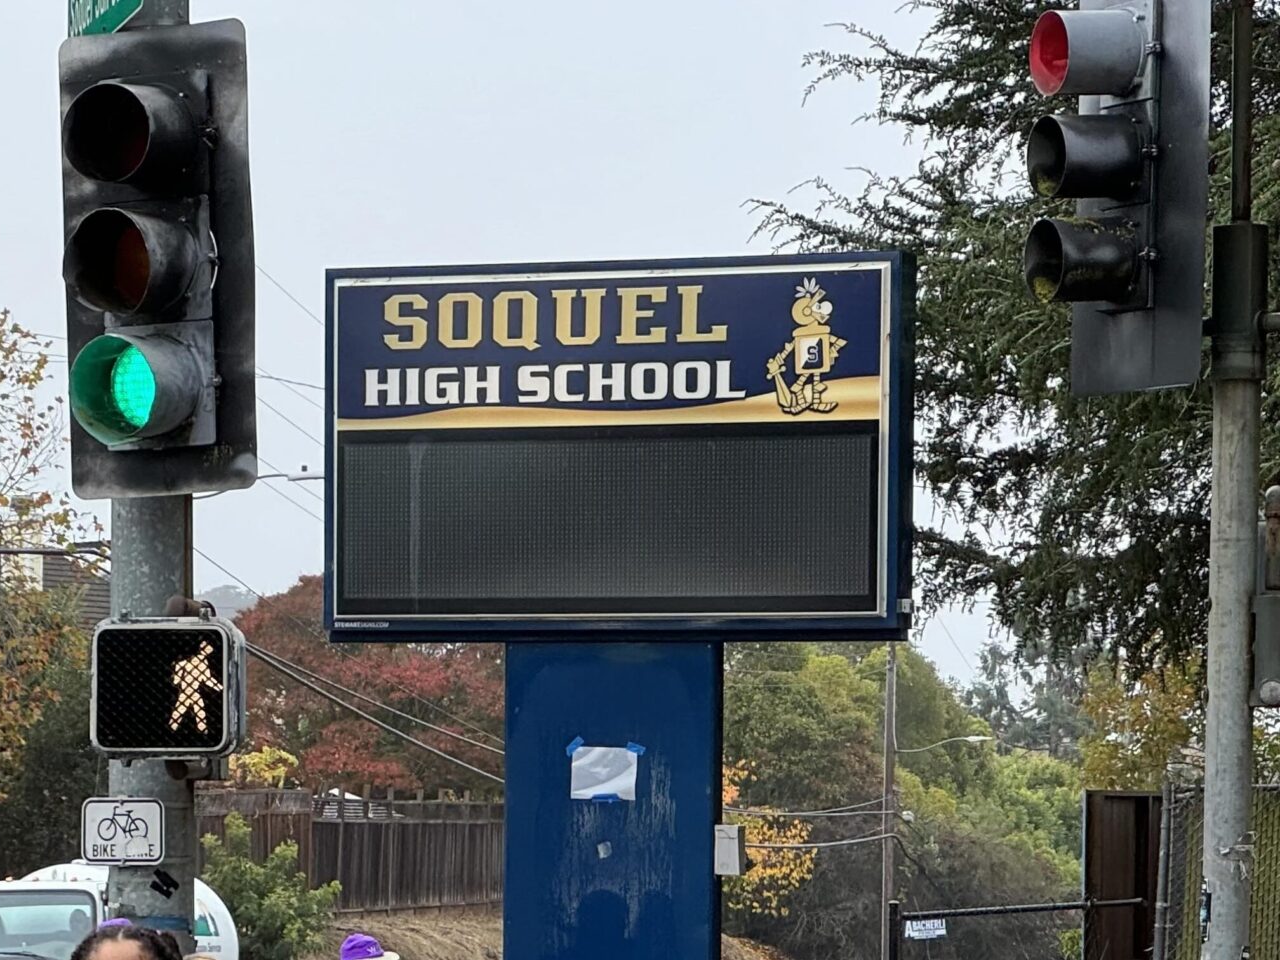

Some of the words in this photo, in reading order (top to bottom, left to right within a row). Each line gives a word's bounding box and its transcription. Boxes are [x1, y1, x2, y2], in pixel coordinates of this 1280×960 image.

[382, 284, 729, 352] SOQUEL
[806, 344, 819, 363] S
[365, 364, 500, 407] HIGH
[517, 359, 747, 404] SCHOOL
[92, 844, 117, 857] BIKE
